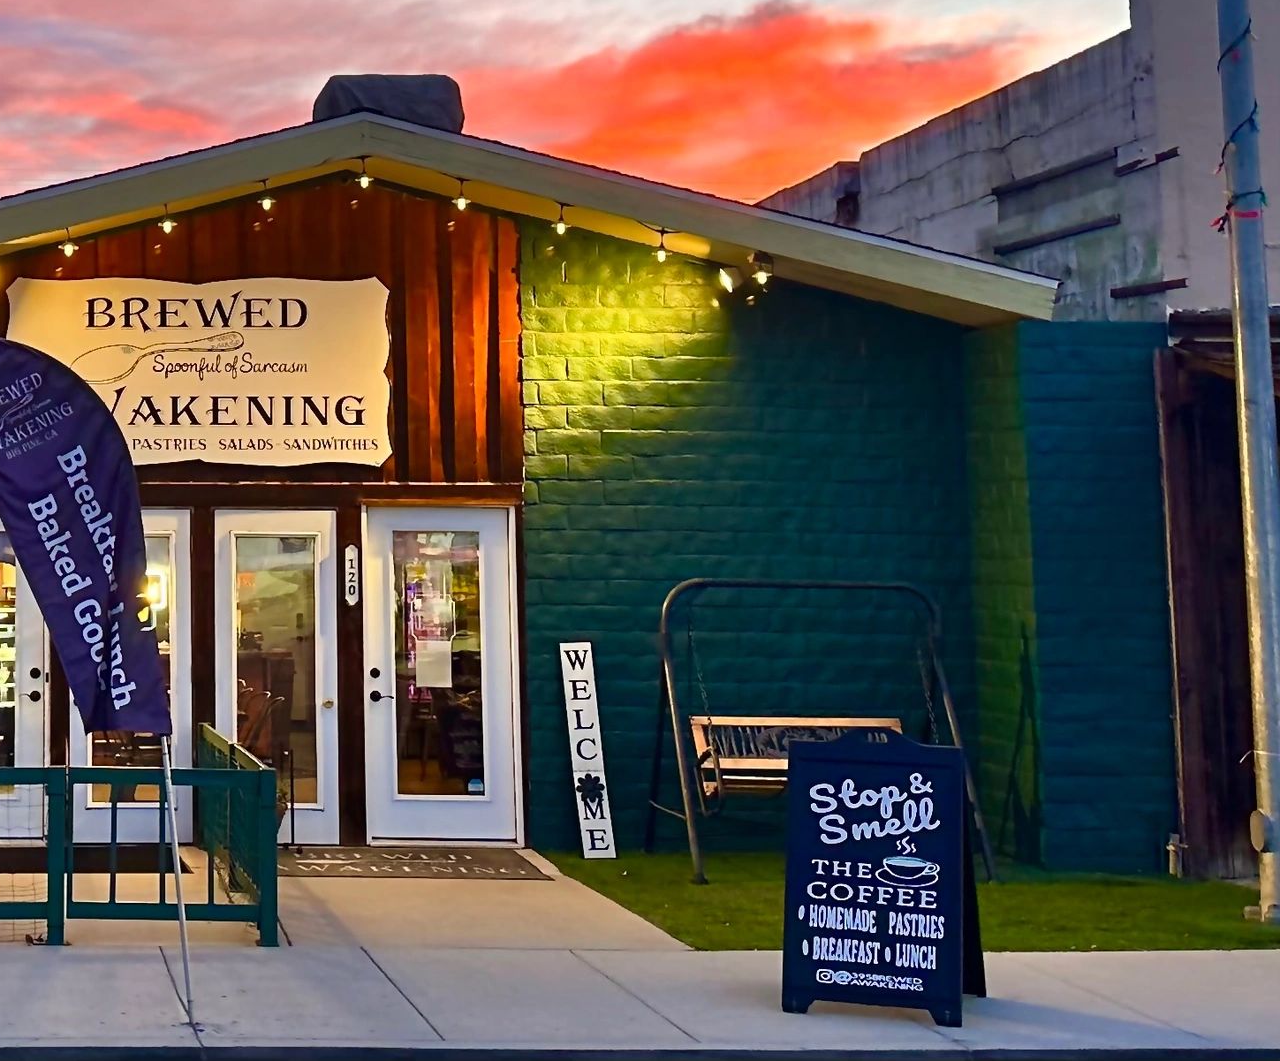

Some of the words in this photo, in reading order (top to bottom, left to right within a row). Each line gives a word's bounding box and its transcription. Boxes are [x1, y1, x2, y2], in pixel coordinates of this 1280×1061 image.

[84, 290, 308, 332] BREWED
[152, 353, 221, 381] Spoonful
[224, 355, 238, 379] of
[239, 351, 308, 374] Sarcasm
[132, 437, 207, 452] PASTRIES
[218, 437, 274, 451] SALADS
[283, 436, 379, 451] SANDWITCHES
[28, 493, 93, 597] Baked
[809, 779, 907, 819] Stop
[909, 772, 933, 794] &
[819, 797, 940, 845] Smell
[811, 859, 872, 879] THE
[806, 882, 938, 909] COFFEE
[808, 904, 877, 934] HOMEMADE
[888, 911, 945, 939] PASTRIES
[812, 936, 881, 965] BREAKFAST
[895, 943, 937, 970] LUNCH
[850, 979, 924, 992] AWAKENING
